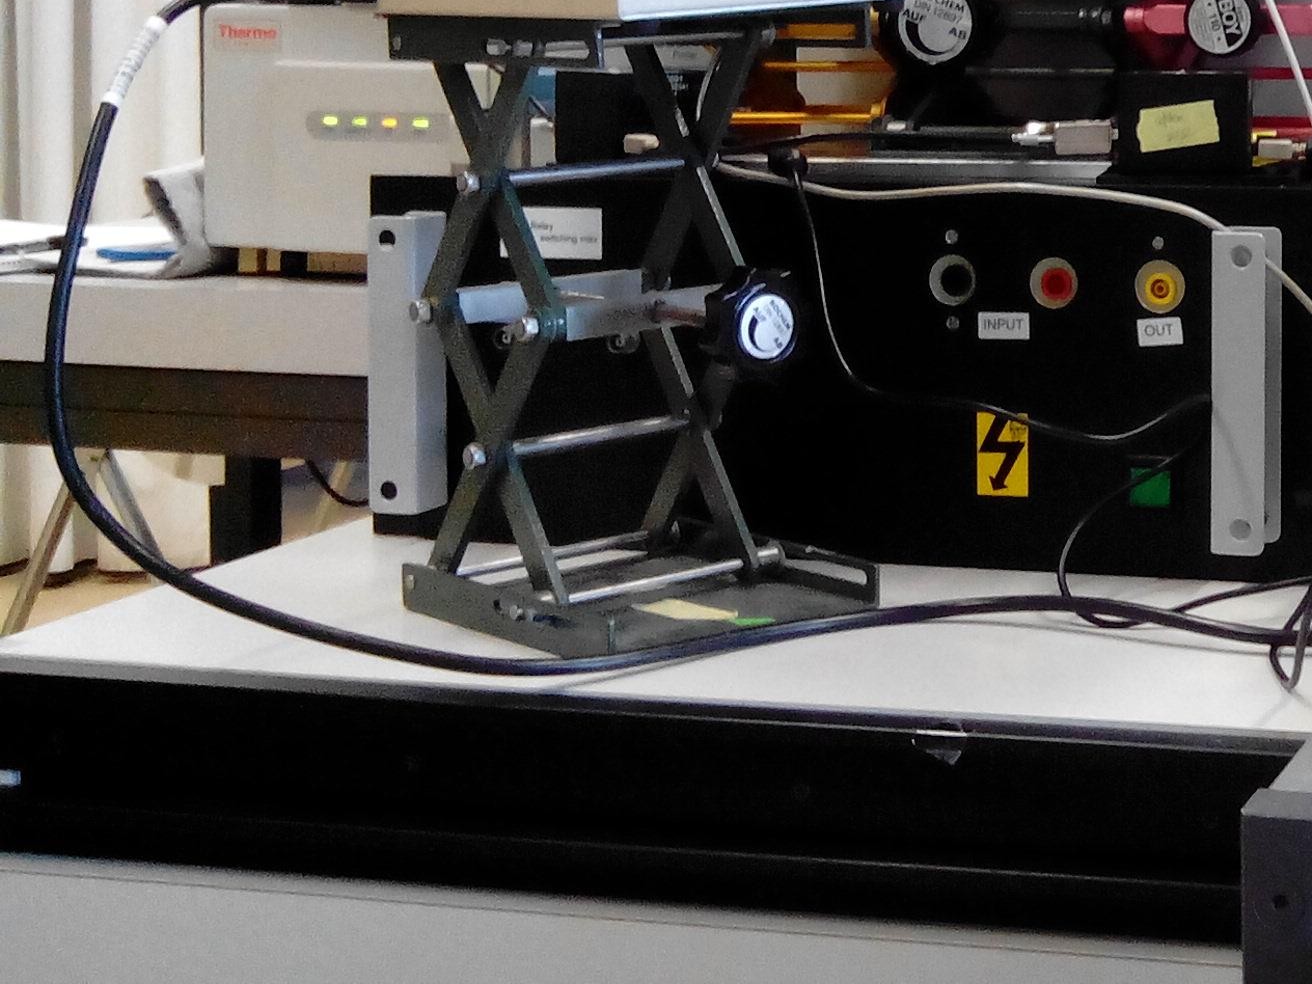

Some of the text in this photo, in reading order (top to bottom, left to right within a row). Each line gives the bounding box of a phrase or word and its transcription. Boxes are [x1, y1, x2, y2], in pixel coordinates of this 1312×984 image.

[219, 23, 277, 39] Thermo
[983, 317, 1024, 330] INPUT
[1143, 323, 1174, 337] OUT
